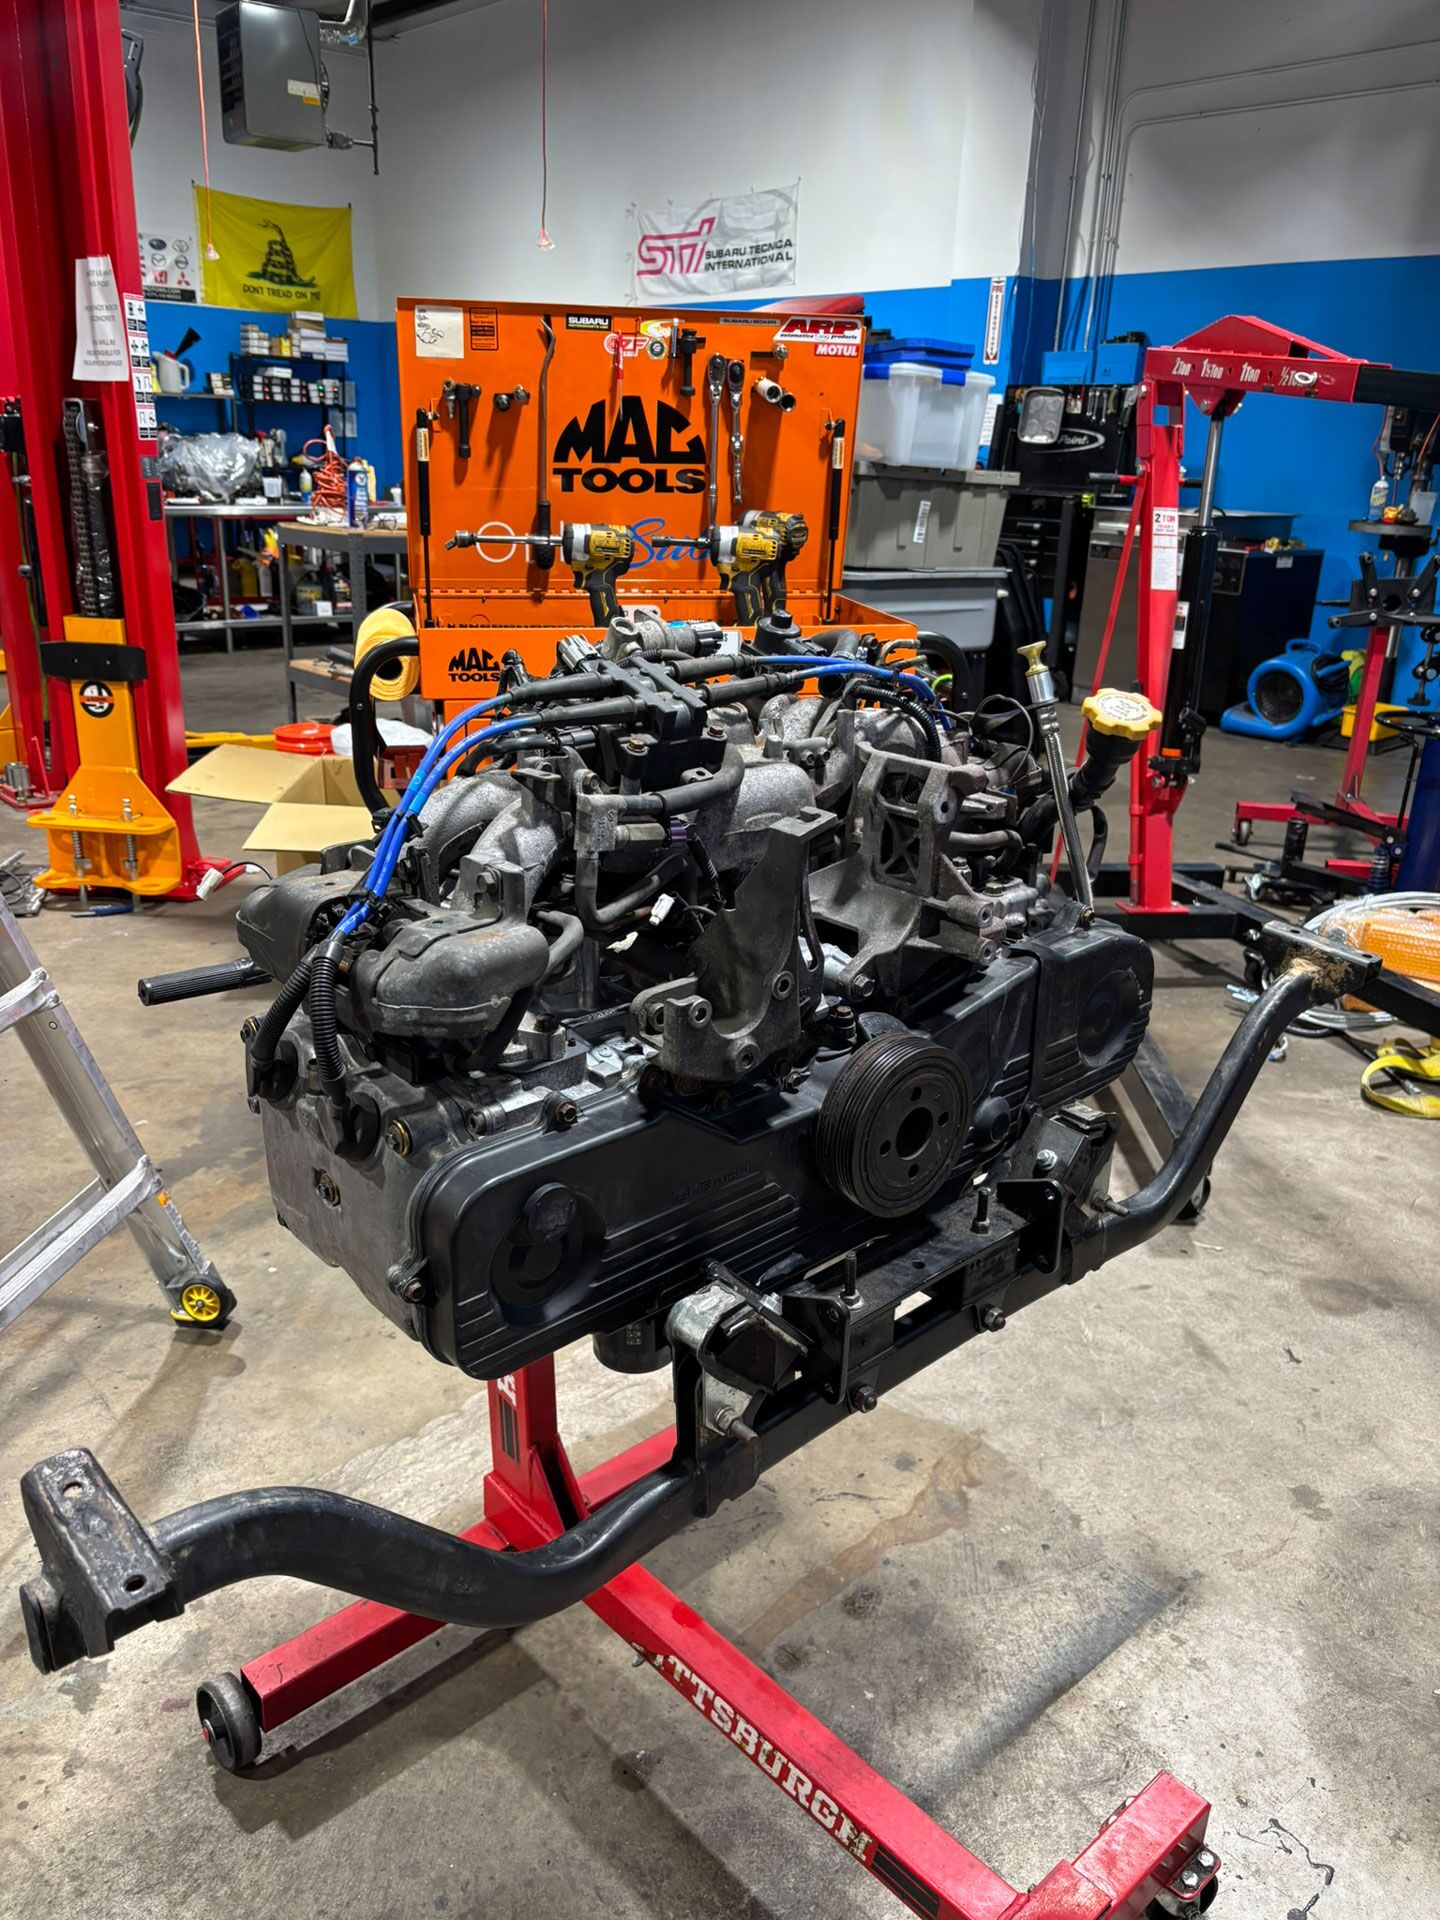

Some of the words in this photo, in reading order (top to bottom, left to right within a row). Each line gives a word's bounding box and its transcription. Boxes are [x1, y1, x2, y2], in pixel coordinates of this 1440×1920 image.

[705, 246, 747, 260] SUBARU
[704, 251, 793, 271] INTERNATIONAL
[266, 286, 293, 299] TREAD
[294, 290, 308, 300] ON
[310, 290, 321, 300] ME
[568, 316, 609, 326] SUBARU
[781, 319, 860, 334] ARP
[815, 343, 858, 356] MOTUL
[553, 396, 706, 464] MAC
[553, 467, 706, 494] TOOLS
[1154, 513, 1161, 523] 2
[448, 647, 500, 671] MAC
[448, 672, 500, 682] TOOLS
